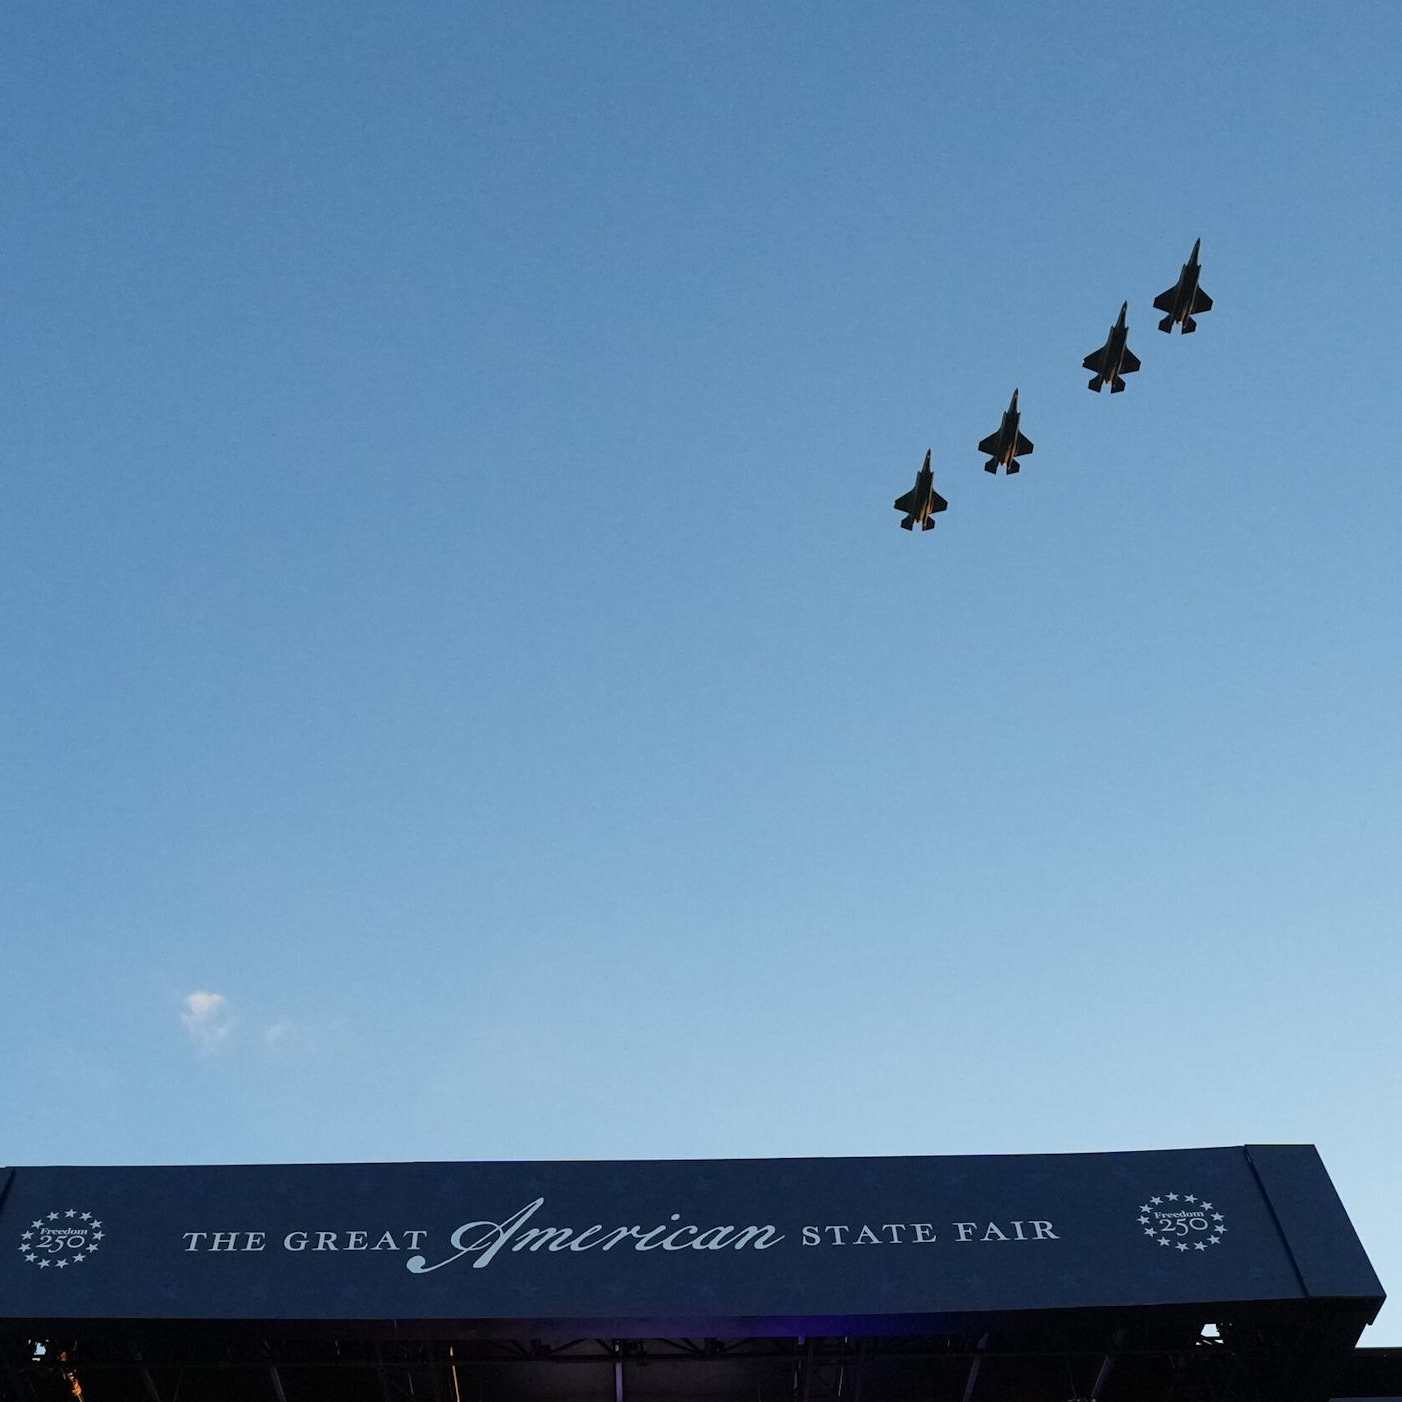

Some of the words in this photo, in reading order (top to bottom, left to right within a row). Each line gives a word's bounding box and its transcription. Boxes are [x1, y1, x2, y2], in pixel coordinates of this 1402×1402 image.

[1154, 1210, 1205, 1218] Freedom
[182, 1231, 266, 1252] THE
[283, 1230, 428, 1252] GREAT
[405, 1197, 786, 1274] American
[802, 1223, 937, 1246] STATE
[952, 1220, 1060, 1243] FAIR
[1159, 1218, 1209, 1236] 250
[35, 1235, 85, 1253] 250
